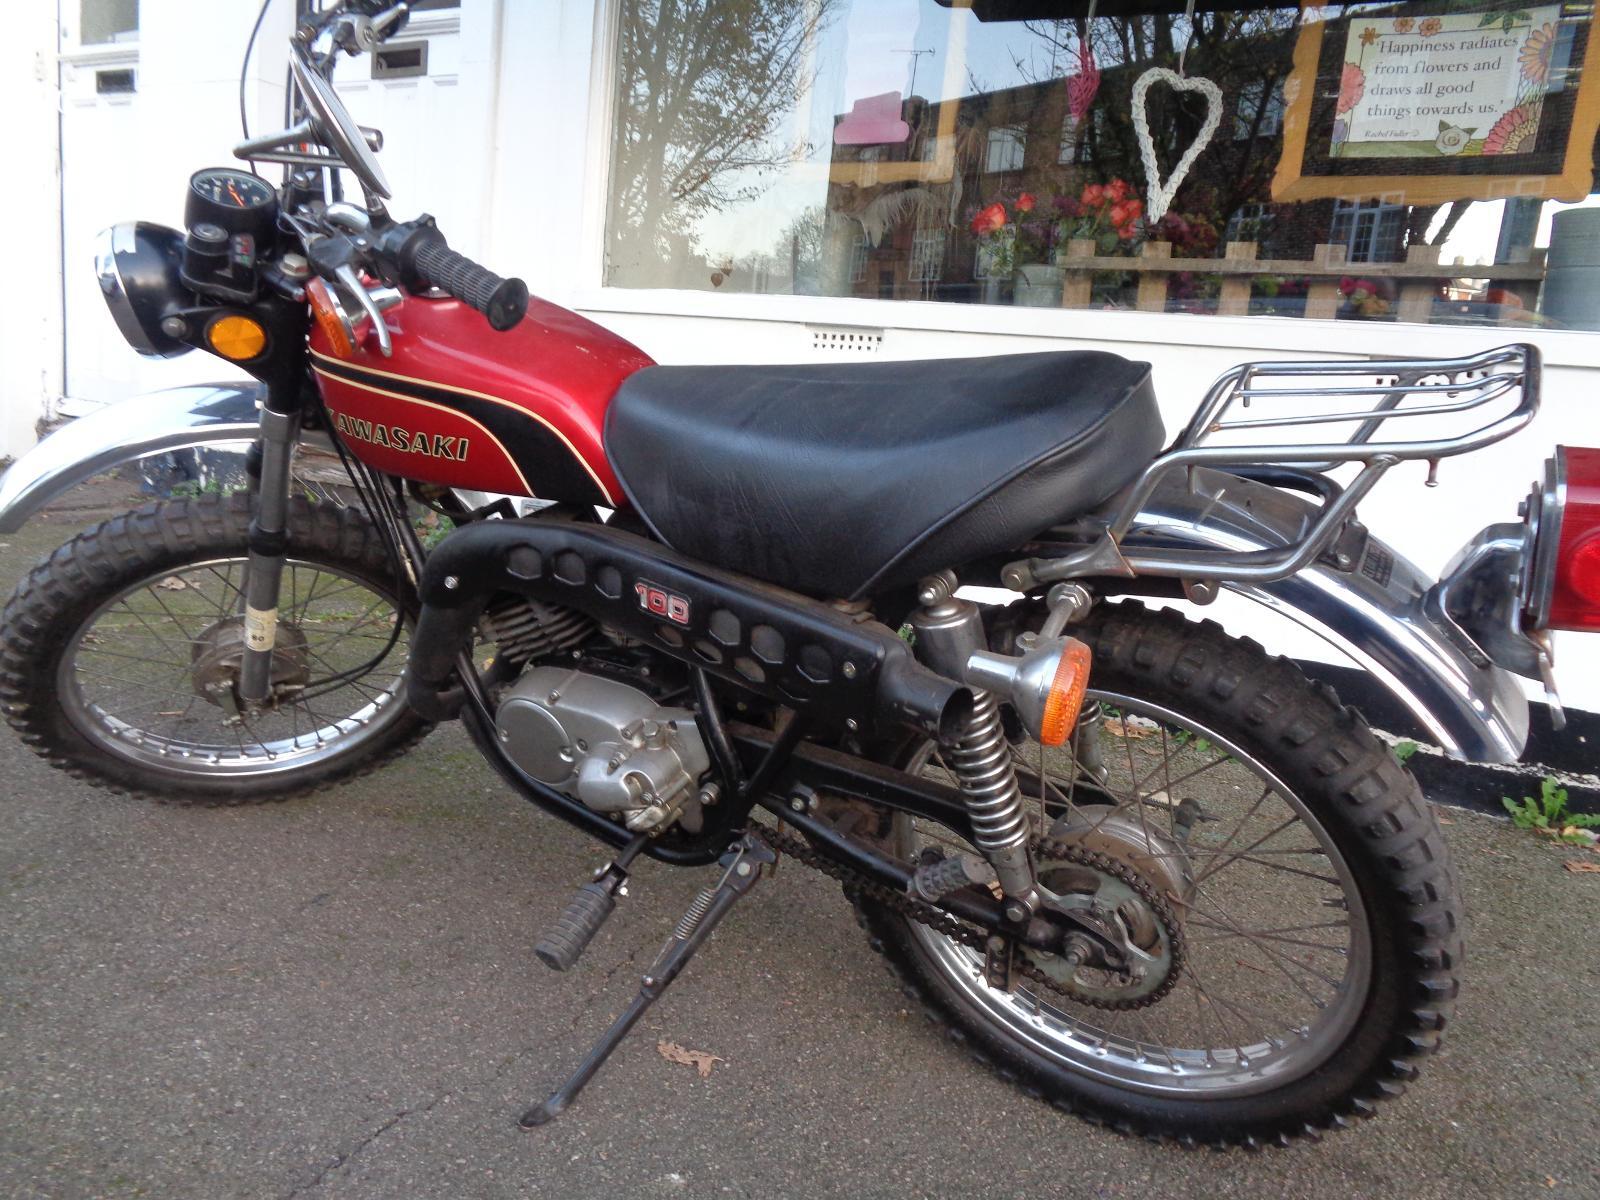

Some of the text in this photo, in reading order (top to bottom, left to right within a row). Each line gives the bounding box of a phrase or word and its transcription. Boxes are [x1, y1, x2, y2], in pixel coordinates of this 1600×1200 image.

[1460, 35, 1519, 50] radiates
[1374, 56, 1502, 75] from flowers and
[1370, 80, 1475, 98] draws all good
[1367, 103, 1411, 120] things
[1416, 101, 1474, 116] towards
[634, 582, 689, 625] 100
